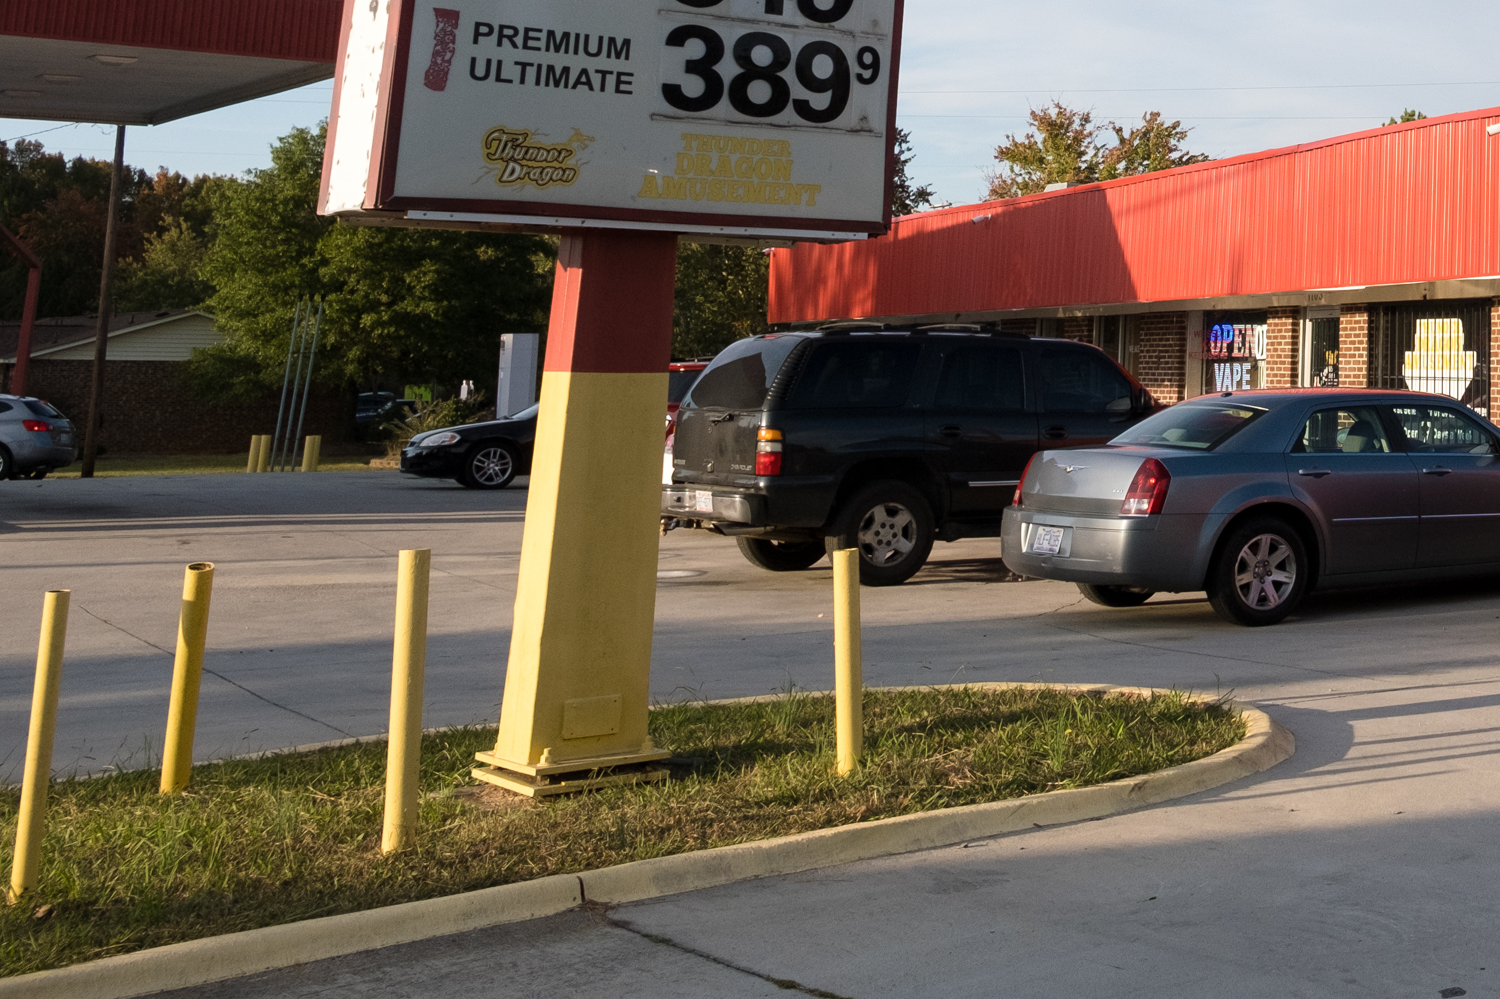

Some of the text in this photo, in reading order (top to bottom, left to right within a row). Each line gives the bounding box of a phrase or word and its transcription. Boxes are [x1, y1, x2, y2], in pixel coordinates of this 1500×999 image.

[472, 21, 632, 62] PREMIUM
[468, 56, 635, 95] ULTIMATE
[661, 24, 881, 124] 389 9
[681, 133, 792, 158] THUNDER
[499, 161, 577, 186] Dragon
[675, 152, 794, 181] DRAGON
[637, 175, 822, 206] AMUSEMENT
[1210, 324, 1257, 357] OPEN
[1214, 363, 1251, 392] VAPE
